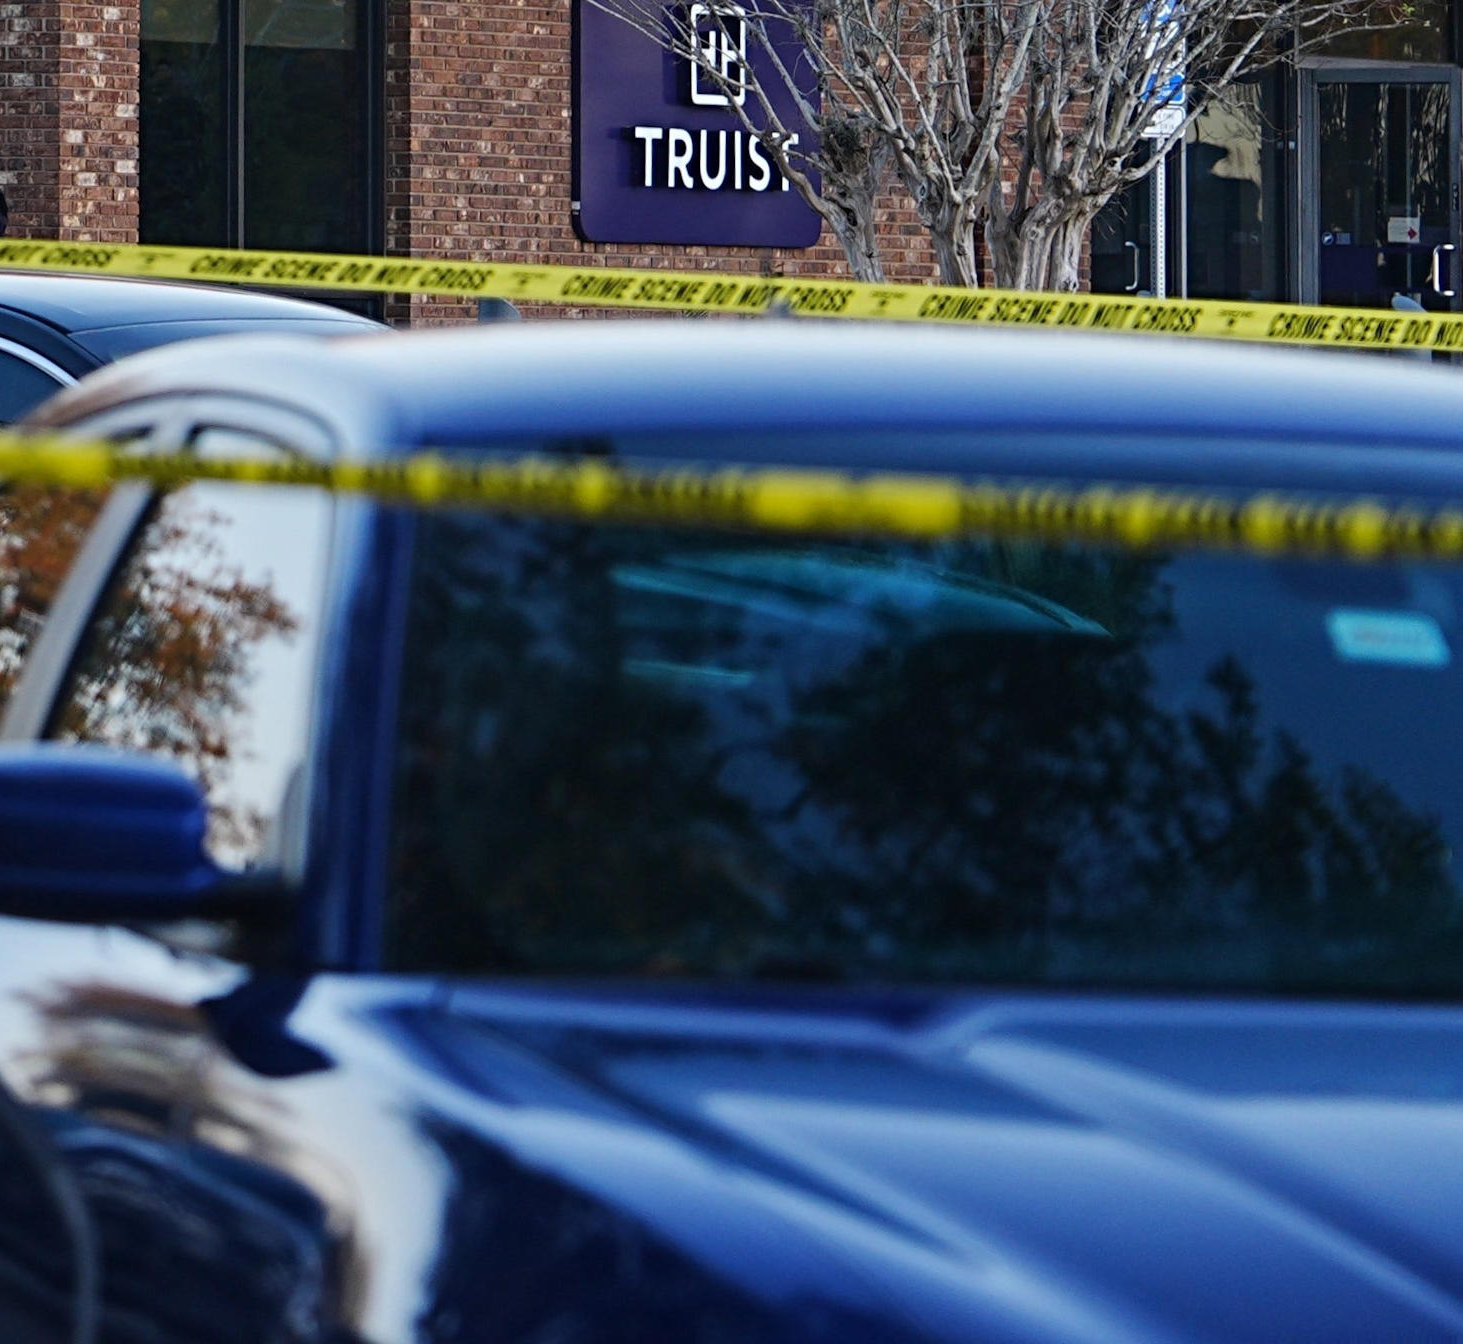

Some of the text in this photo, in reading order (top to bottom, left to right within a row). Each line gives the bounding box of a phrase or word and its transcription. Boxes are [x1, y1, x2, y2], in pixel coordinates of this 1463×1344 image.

[634, 126, 799, 192] TRUIST
[190, 255, 266, 276] CRIME
[263, 259, 338, 280] SCENE
[337, 263, 374, 283] DO
[374, 264, 422, 285] NOT
[418, 267, 493, 289] CROSS
[561, 275, 635, 299] CRIME
[633, 278, 705, 302] SCENE
[702, 282, 737, 305] DO
[785, 286, 853, 312] CROSS
[918, 294, 992, 320] CRIME
[988, 297, 1058, 323] SCENE
[1057, 301, 1089, 325] DO
[1090, 303, 1132, 328] NOT
[1131, 306, 1202, 332] CROSS
[1267, 312, 1336, 339] CRIME
[1334, 316, 1402, 343] SCENE
[1401, 319, 1431, 344] DO
